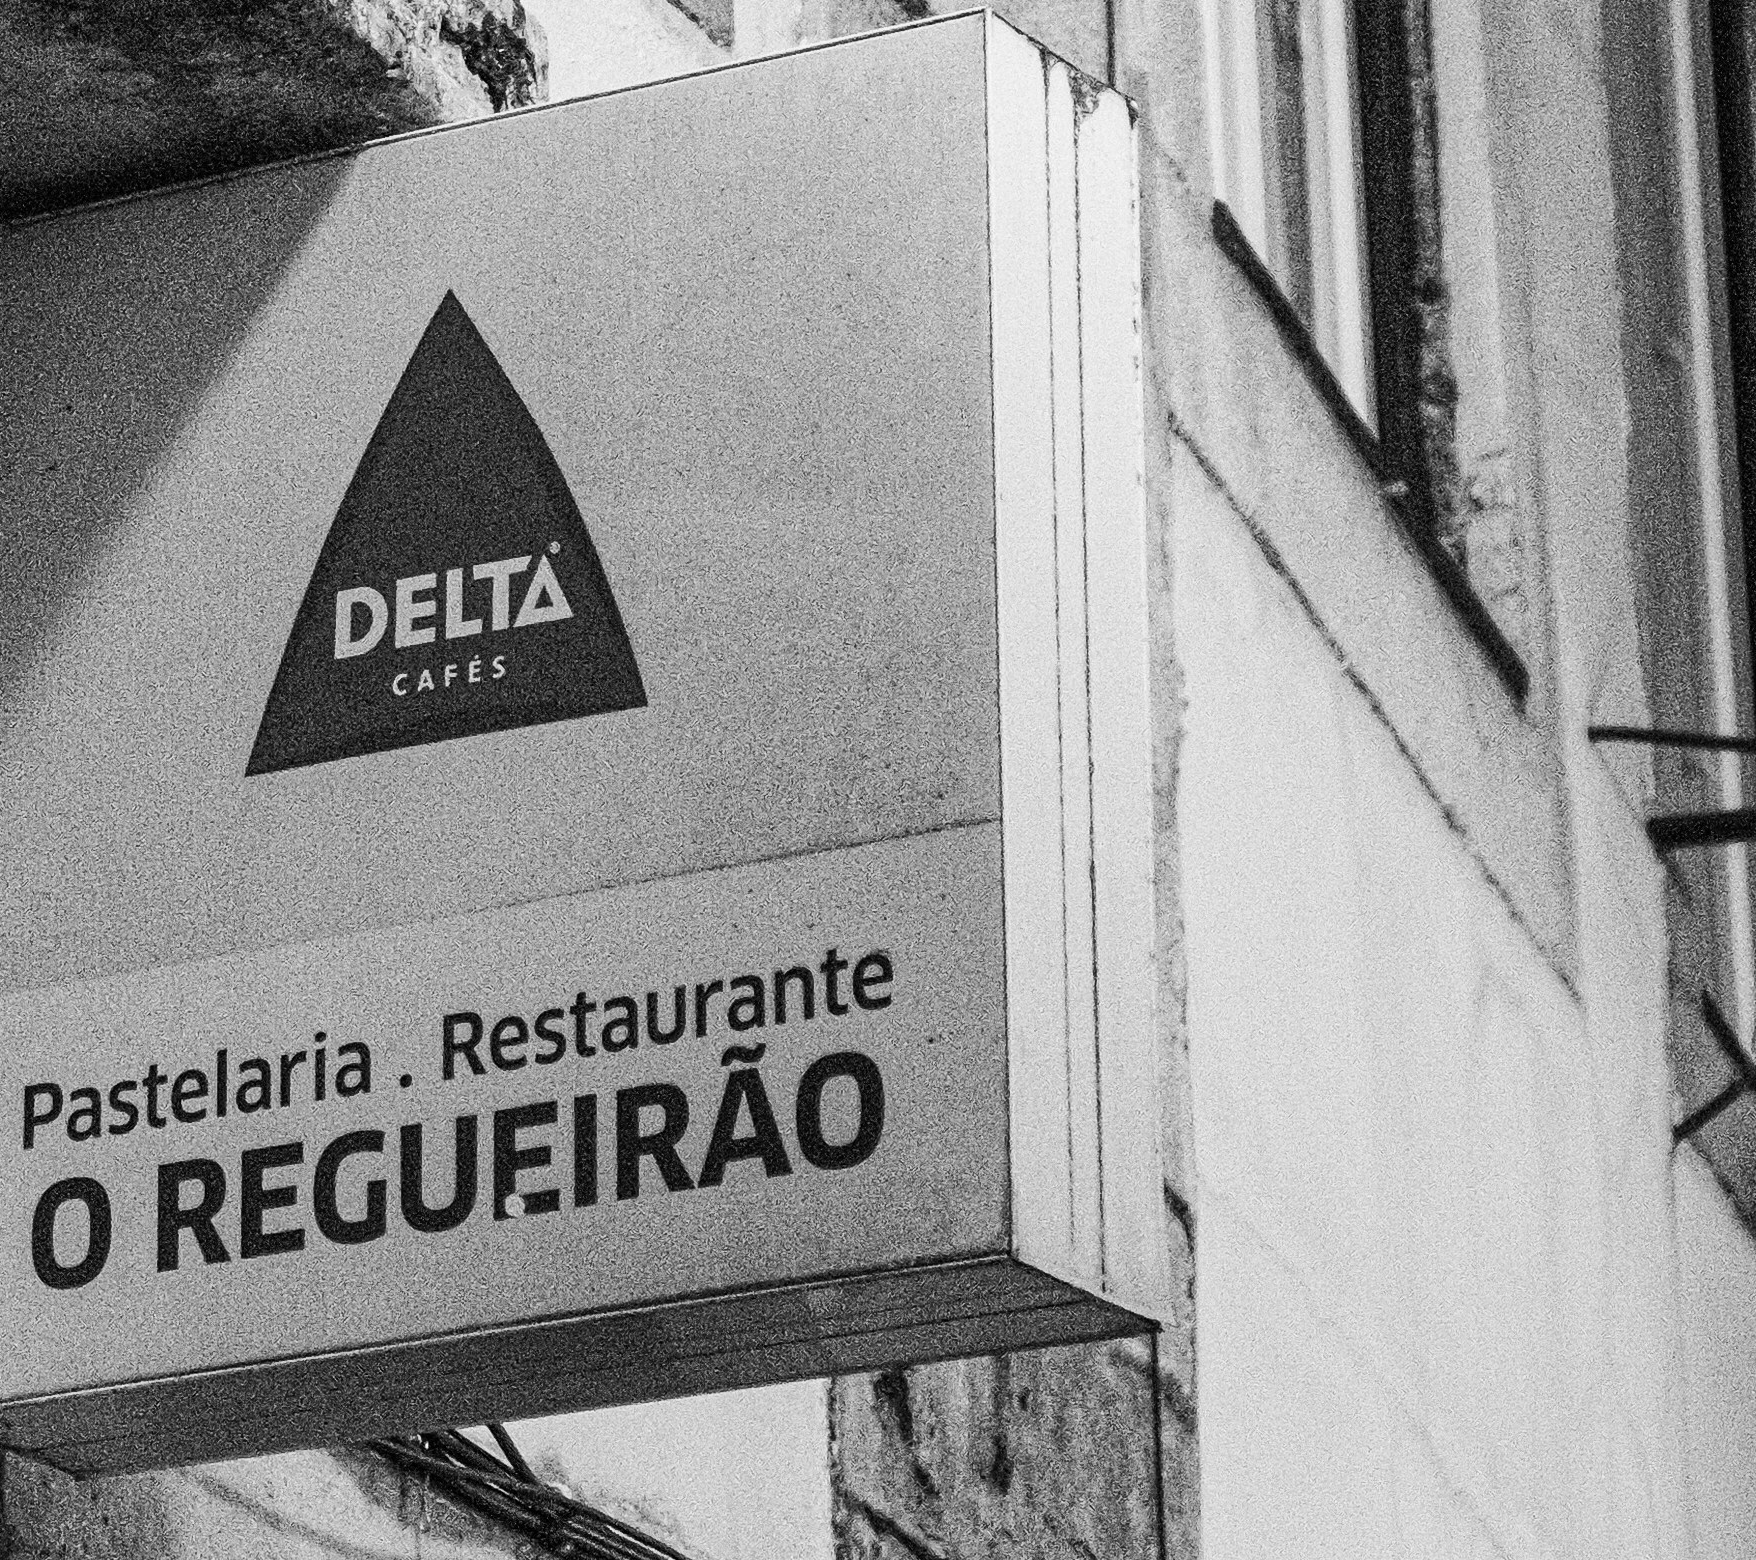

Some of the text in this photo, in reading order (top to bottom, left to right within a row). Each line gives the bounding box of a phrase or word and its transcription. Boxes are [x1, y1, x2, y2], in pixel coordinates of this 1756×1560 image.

[392, 654, 507, 697] CAFÉS
[22, 1029, 371, 1150] Pastelaria
[442, 947, 894, 1082] Restaurante
[30, 1044, 887, 1292] O REGUEIRÃO
